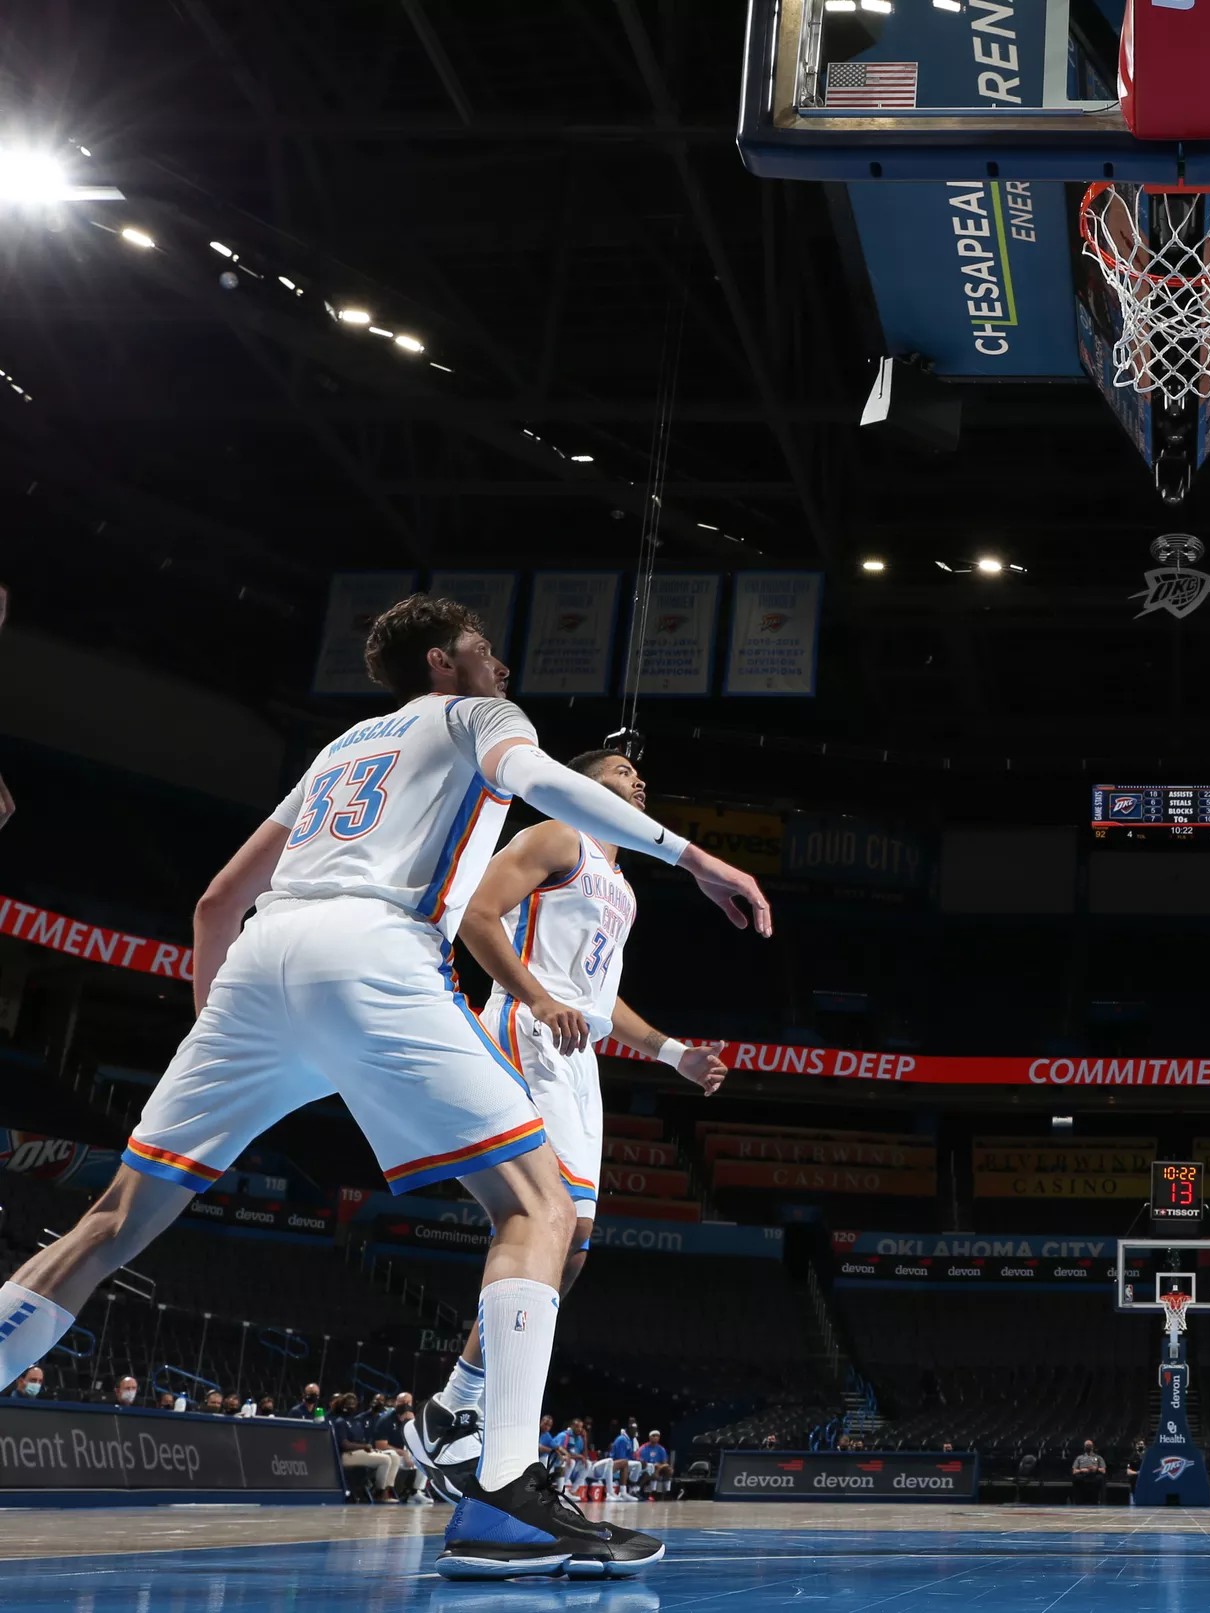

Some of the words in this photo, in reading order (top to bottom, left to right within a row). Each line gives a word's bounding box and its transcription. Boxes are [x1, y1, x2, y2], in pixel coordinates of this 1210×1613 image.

[969, 0, 1022, 104] REN
[946, 181, 1009, 356] CHESAPEA
[328, 715, 420, 758] MOSCALA
[286, 749, 401, 850] 33
[1168, 807, 1193, 815] BLOCKS
[1170, 826, 1194, 835] 10:22
[789, 831, 857, 870] LOUD
[866, 834, 920, 881] CITY
[581, 873, 632, 918] OKLAHO
[601, 905, 624, 942] CITY
[734, 1044, 826, 1076] RUNS
[834, 1051, 916, 1080] DEEP
[5, 1138, 73, 1172] OKC
[264, 1176, 287, 1191] 118
[772, 1168, 881, 1192] CASINO
[1164, 1167, 1196, 1181] 10:22
[341, 1188, 363, 1203] 119
[1012, 1178, 1117, 1195] CASINO
[1171, 1181, 1193, 1205] 13
[235, 1208, 275, 1225] devon
[287, 1213, 326, 1230] devon
[1166, 1208, 1200, 1217] TISSOT
[763, 1228, 783, 1240] 119
[833, 1231, 856, 1244] 120
[877, 1239, 1032, 1258] OKLAHOMA
[1041, 1242, 1105, 1258] CITY
[841, 1262, 875, 1275] devon
[895, 1264, 928, 1276] devon
[948, 1265, 981, 1278] devon
[1001, 1266, 1034, 1278] devon
[1054, 1266, 1087, 1278] devon
[1170, 1374, 1181, 1409] devon
[1159, 1434, 1186, 1444] Health
[72, 1428, 135, 1470] Runs
[139, 1432, 200, 1481] Deep
[271, 1454, 308, 1476] devon
[733, 1472, 795, 1489] devon
[813, 1472, 874, 1489] devon
[893, 1473, 954, 1490] devon
